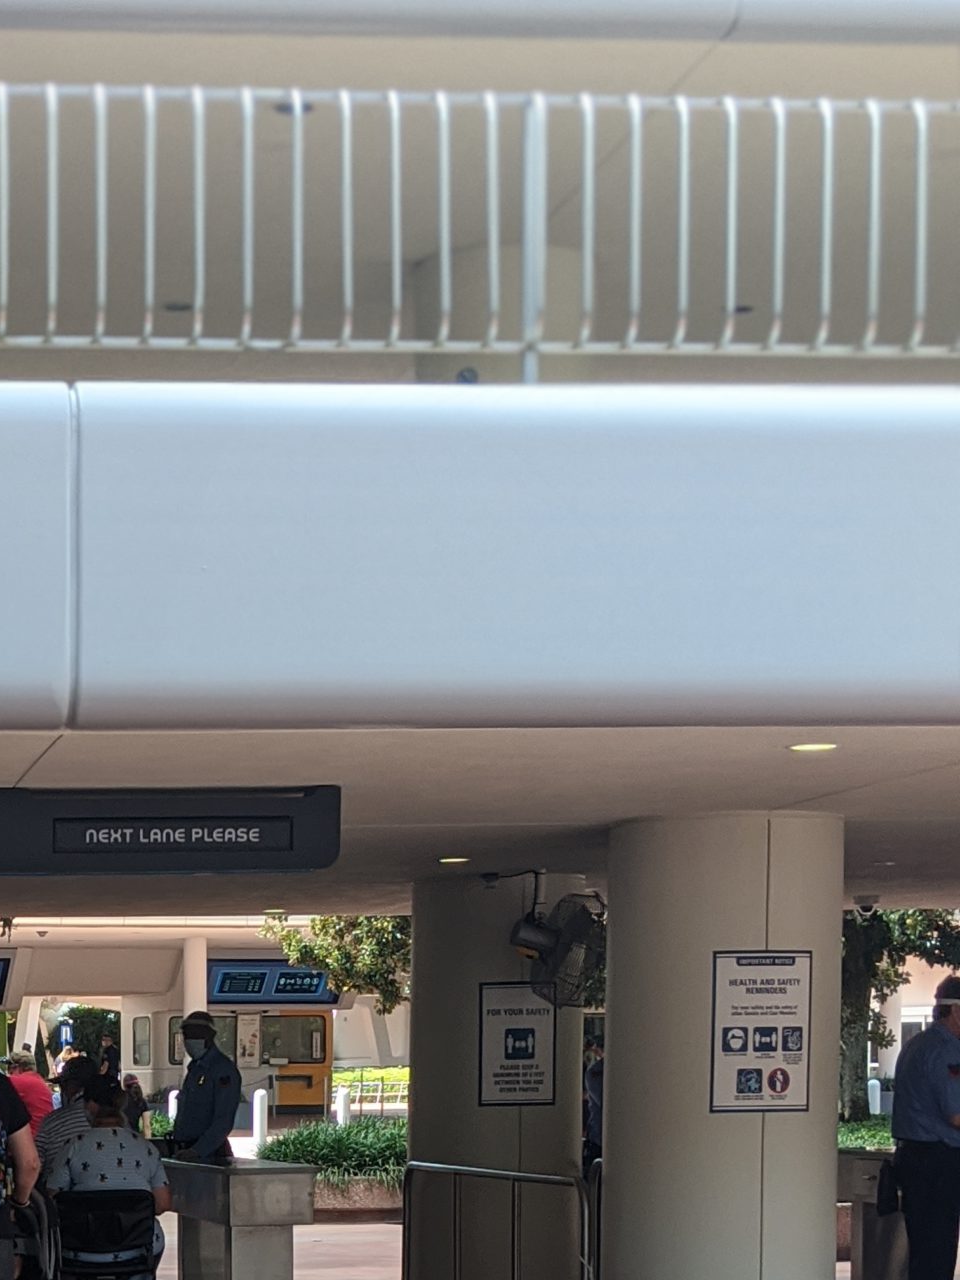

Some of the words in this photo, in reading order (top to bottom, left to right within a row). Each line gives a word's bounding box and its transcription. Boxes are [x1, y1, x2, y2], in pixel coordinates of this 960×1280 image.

[85, 828, 134, 843] NEXT
[139, 828, 186, 843] LANE
[191, 828, 260, 842] PLEASE
[729, 978, 758, 986] HEALTH
[760, 978, 775, 986] AND
[777, 978, 801, 986] SAFETY
[487, 1008, 501, 1016] FOR
[504, 1008, 524, 1016] YOUR
[526, 1008, 550, 1016] SAFETY
